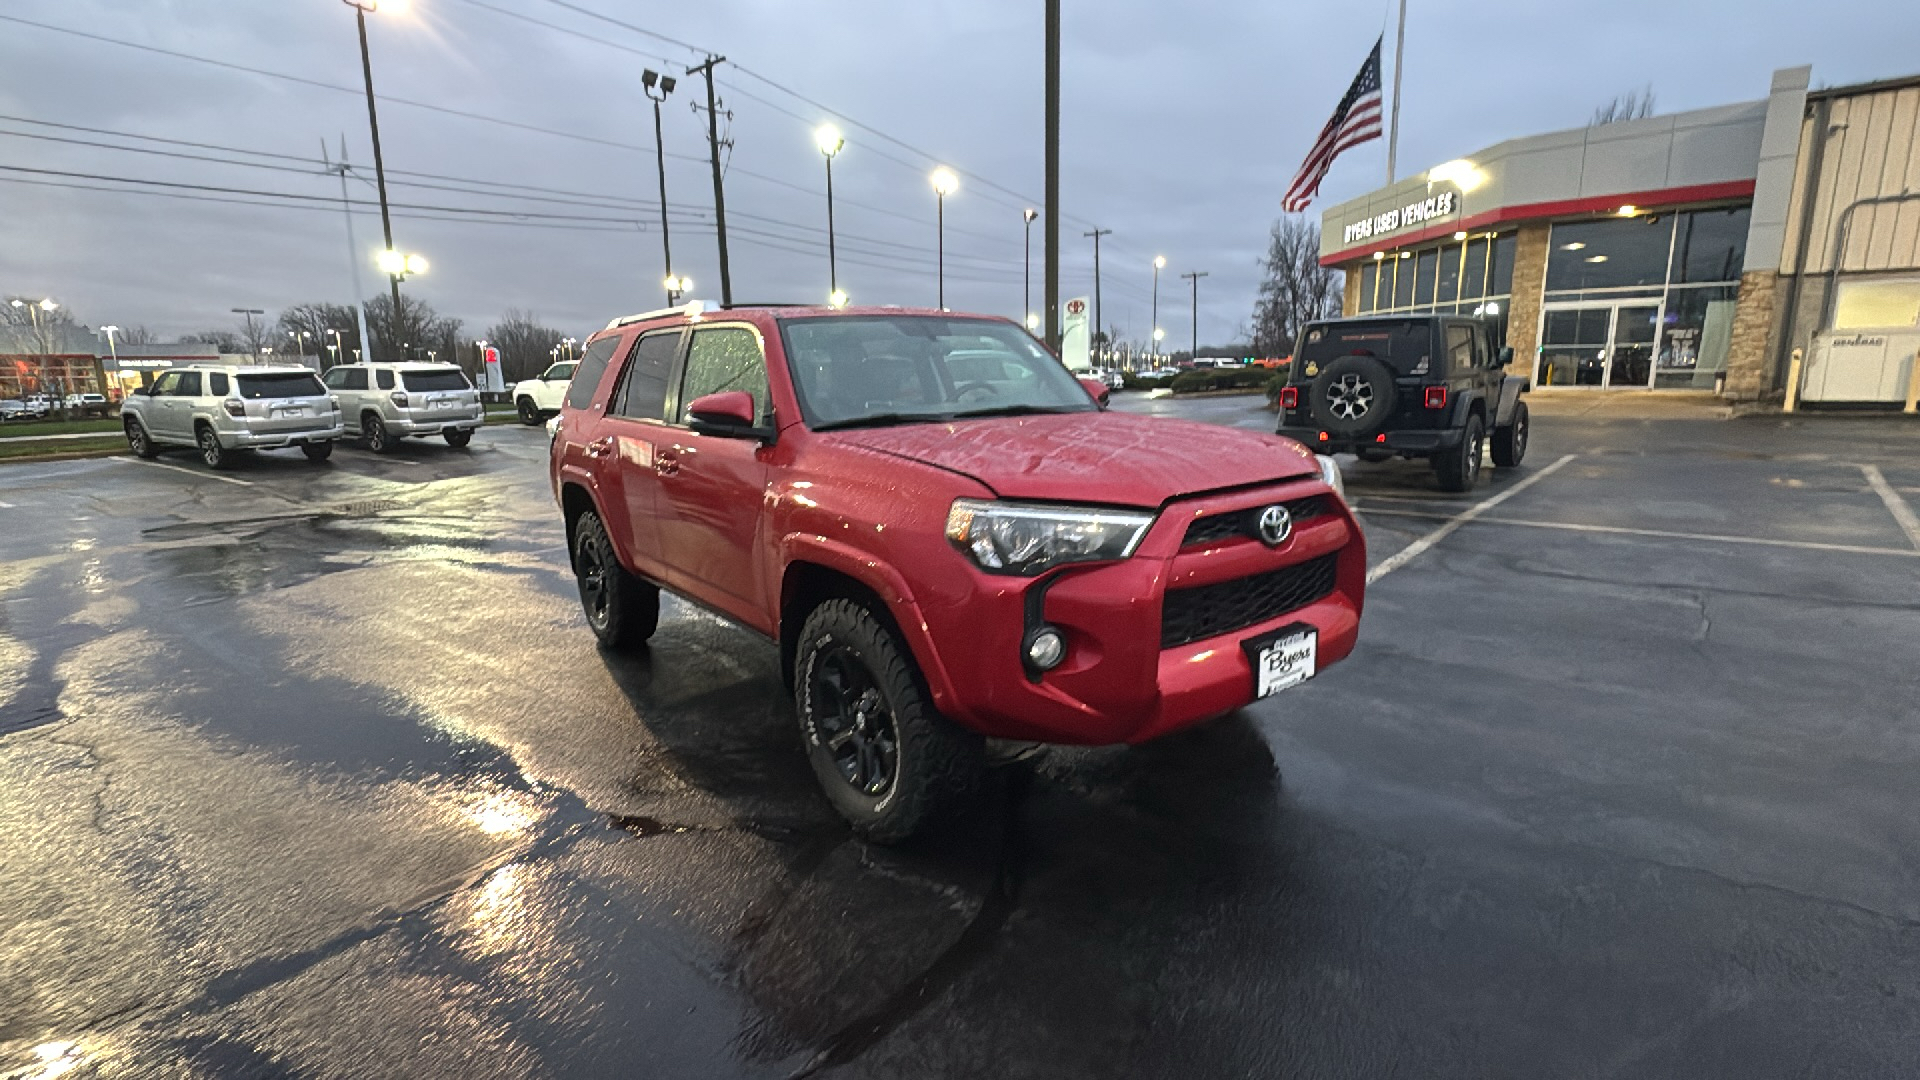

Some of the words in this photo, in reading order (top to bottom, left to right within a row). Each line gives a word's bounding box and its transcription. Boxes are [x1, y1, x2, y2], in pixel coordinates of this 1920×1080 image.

[1344, 217, 1373, 244] BYERS
[1373, 209, 1399, 235] USED
[1401, 191, 1453, 227] VEHICLES
[1264, 647, 1311, 673] Byers
